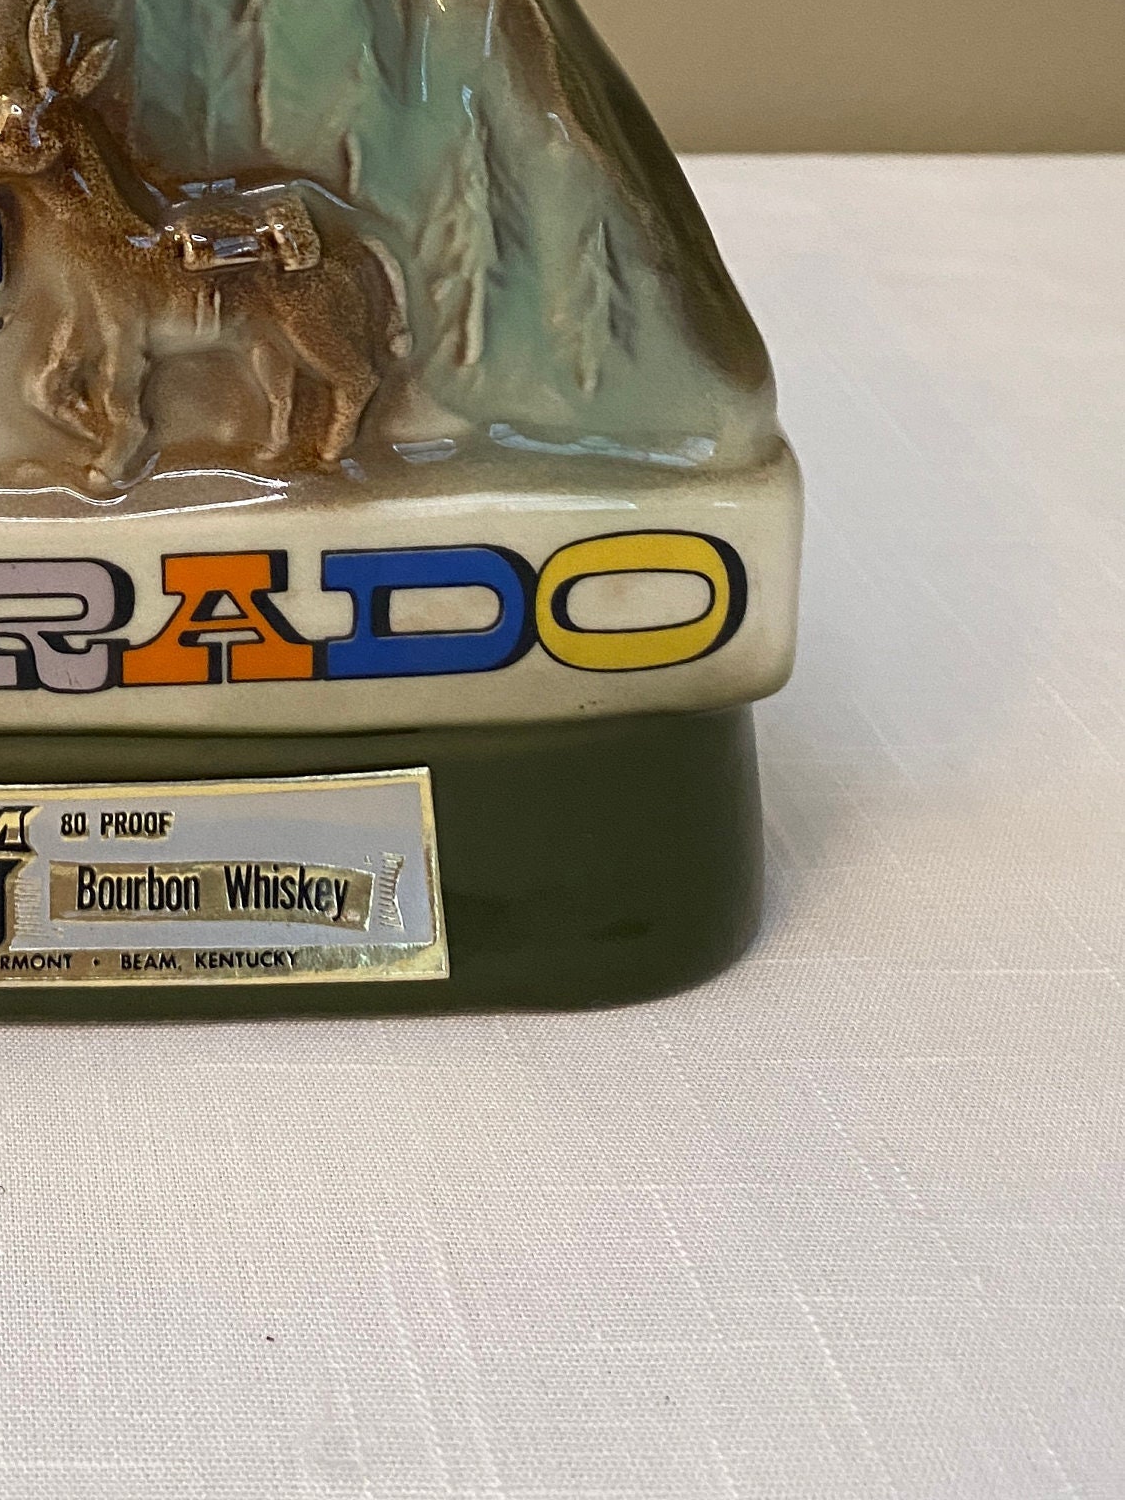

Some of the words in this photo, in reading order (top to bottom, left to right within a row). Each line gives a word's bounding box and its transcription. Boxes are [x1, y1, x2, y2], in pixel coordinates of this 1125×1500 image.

[60, 812, 88, 837] 80
[100, 812, 173, 836] PROOF
[76, 864, 200, 912] Bourbon
[223, 864, 349, 921] Whiskey
[194, 950, 299, 970] KENTUCKY
